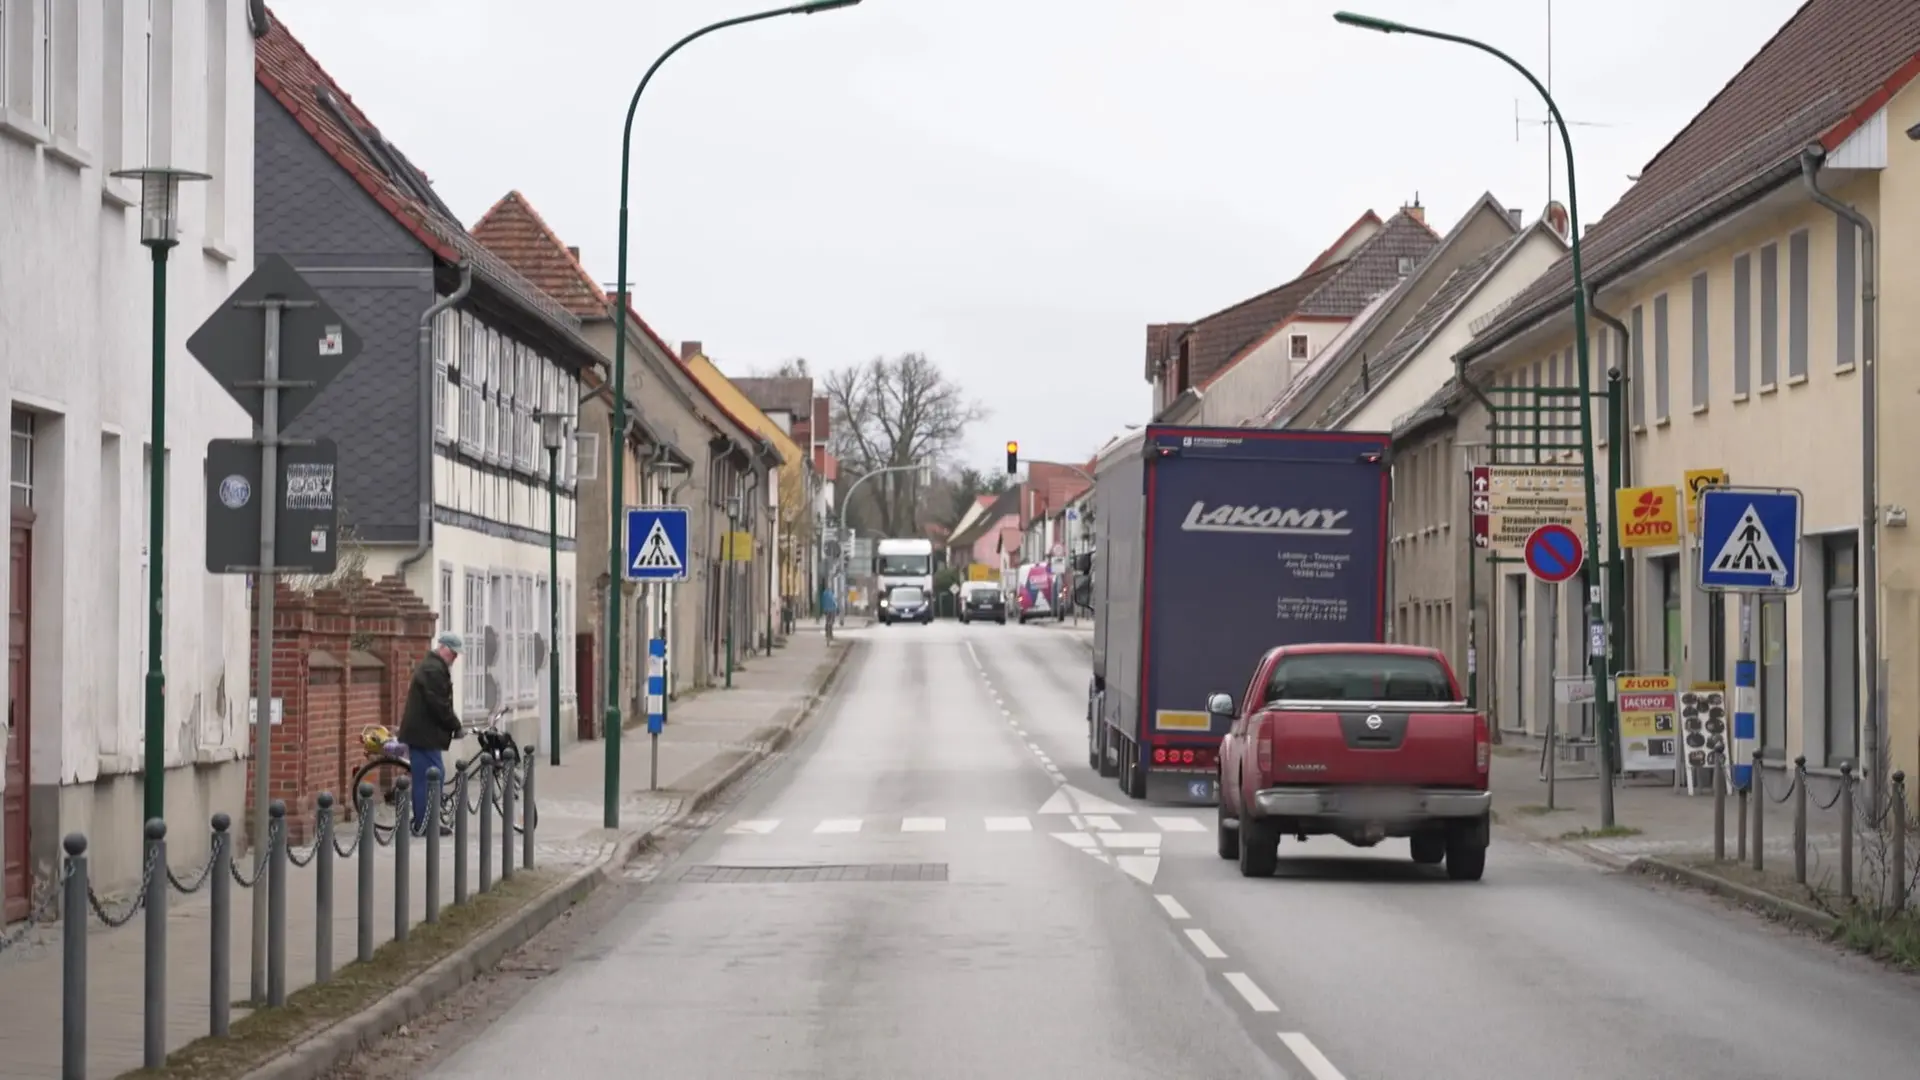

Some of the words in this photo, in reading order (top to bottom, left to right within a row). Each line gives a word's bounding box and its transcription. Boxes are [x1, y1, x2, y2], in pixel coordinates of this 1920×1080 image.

[1181, 501, 1353, 535] LAKOMY
[1625, 521, 1673, 536] LOTTO
[1639, 679, 1669, 689] LOTTO
[1624, 696, 1667, 709] JACKPOT
[1656, 715, 1672, 730] 27
[1662, 740, 1674, 754] 10
